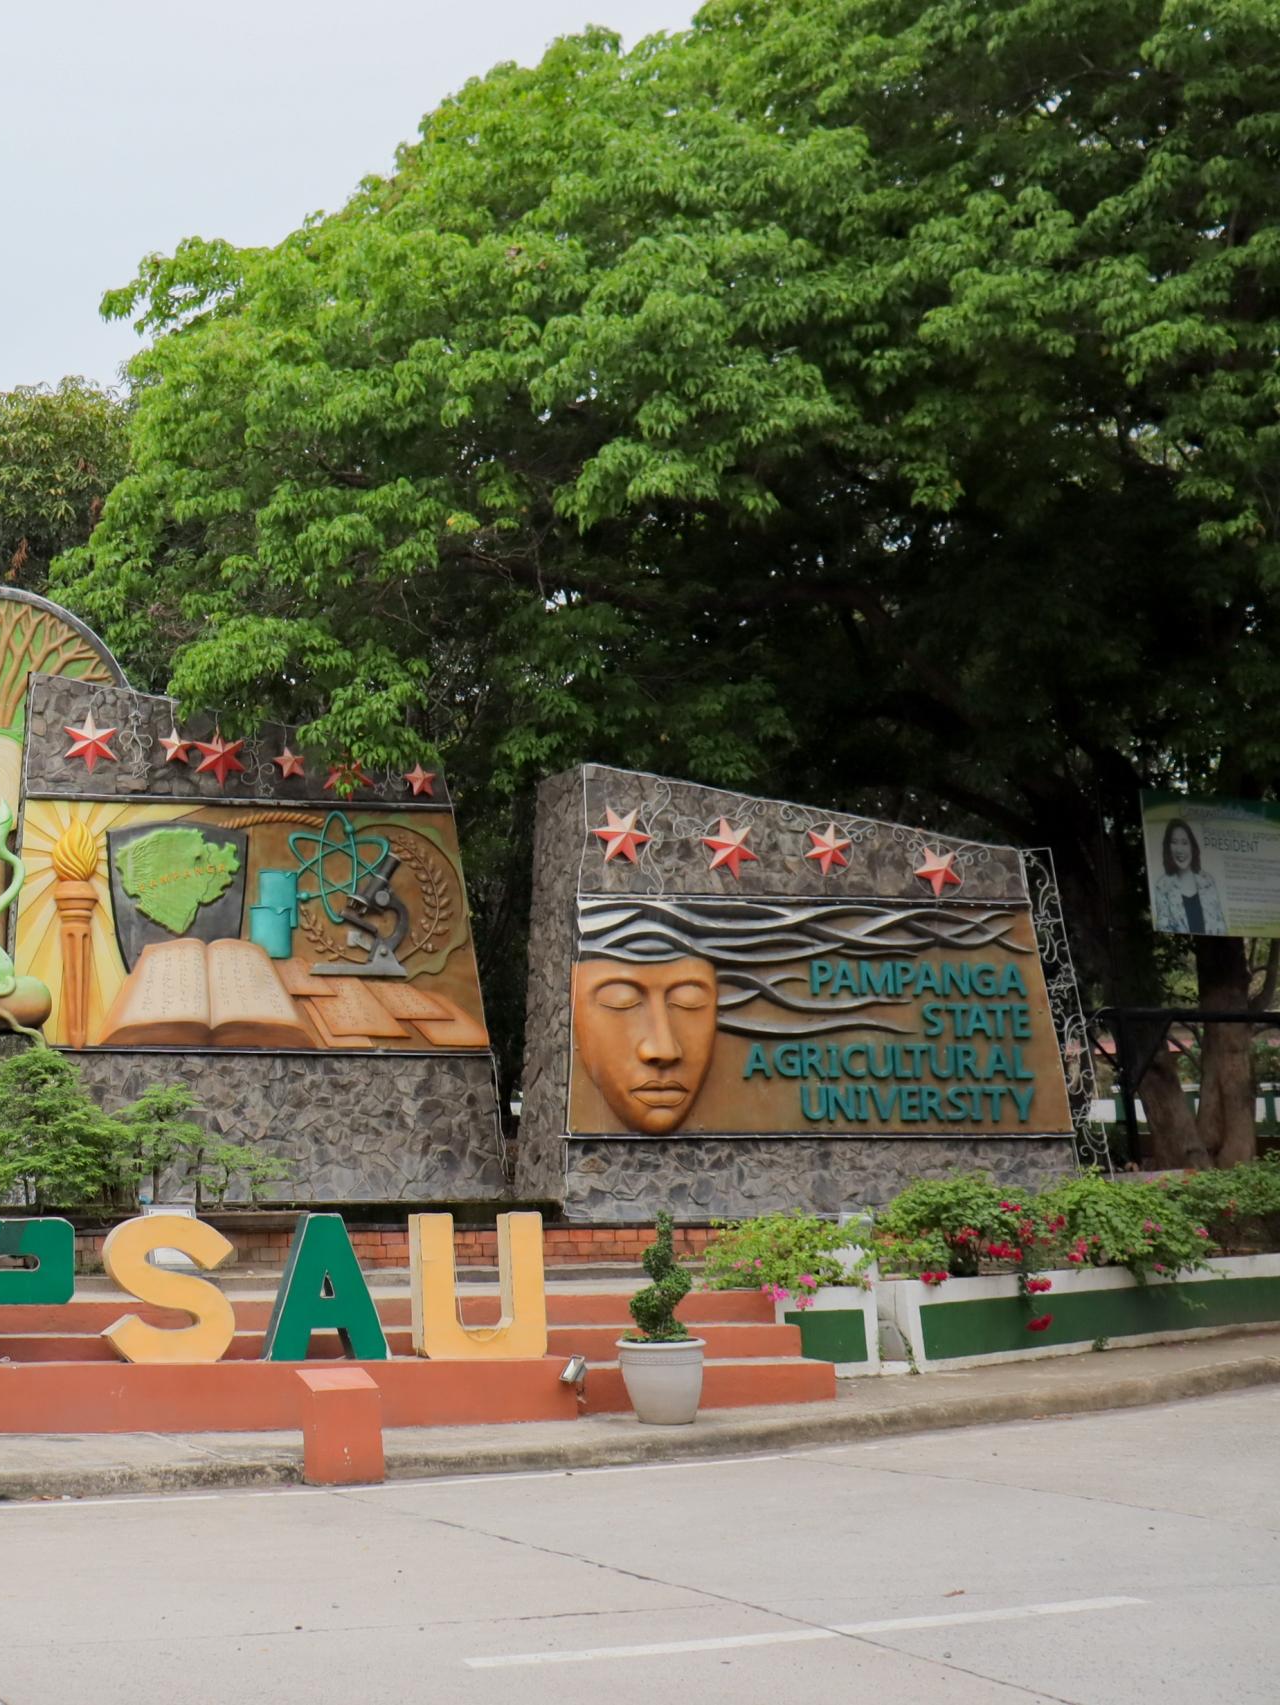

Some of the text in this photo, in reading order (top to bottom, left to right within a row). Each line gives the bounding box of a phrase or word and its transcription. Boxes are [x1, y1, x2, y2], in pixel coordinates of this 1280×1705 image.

[1203, 836, 1259, 853] PRESIDENT
[809, 960, 1028, 998] PAMPANGA
[922, 1003, 1032, 1039] STATE
[742, 1043, 1035, 1080] AGRICULTURAL
[800, 1085, 1035, 1123] UNIVERSITY
